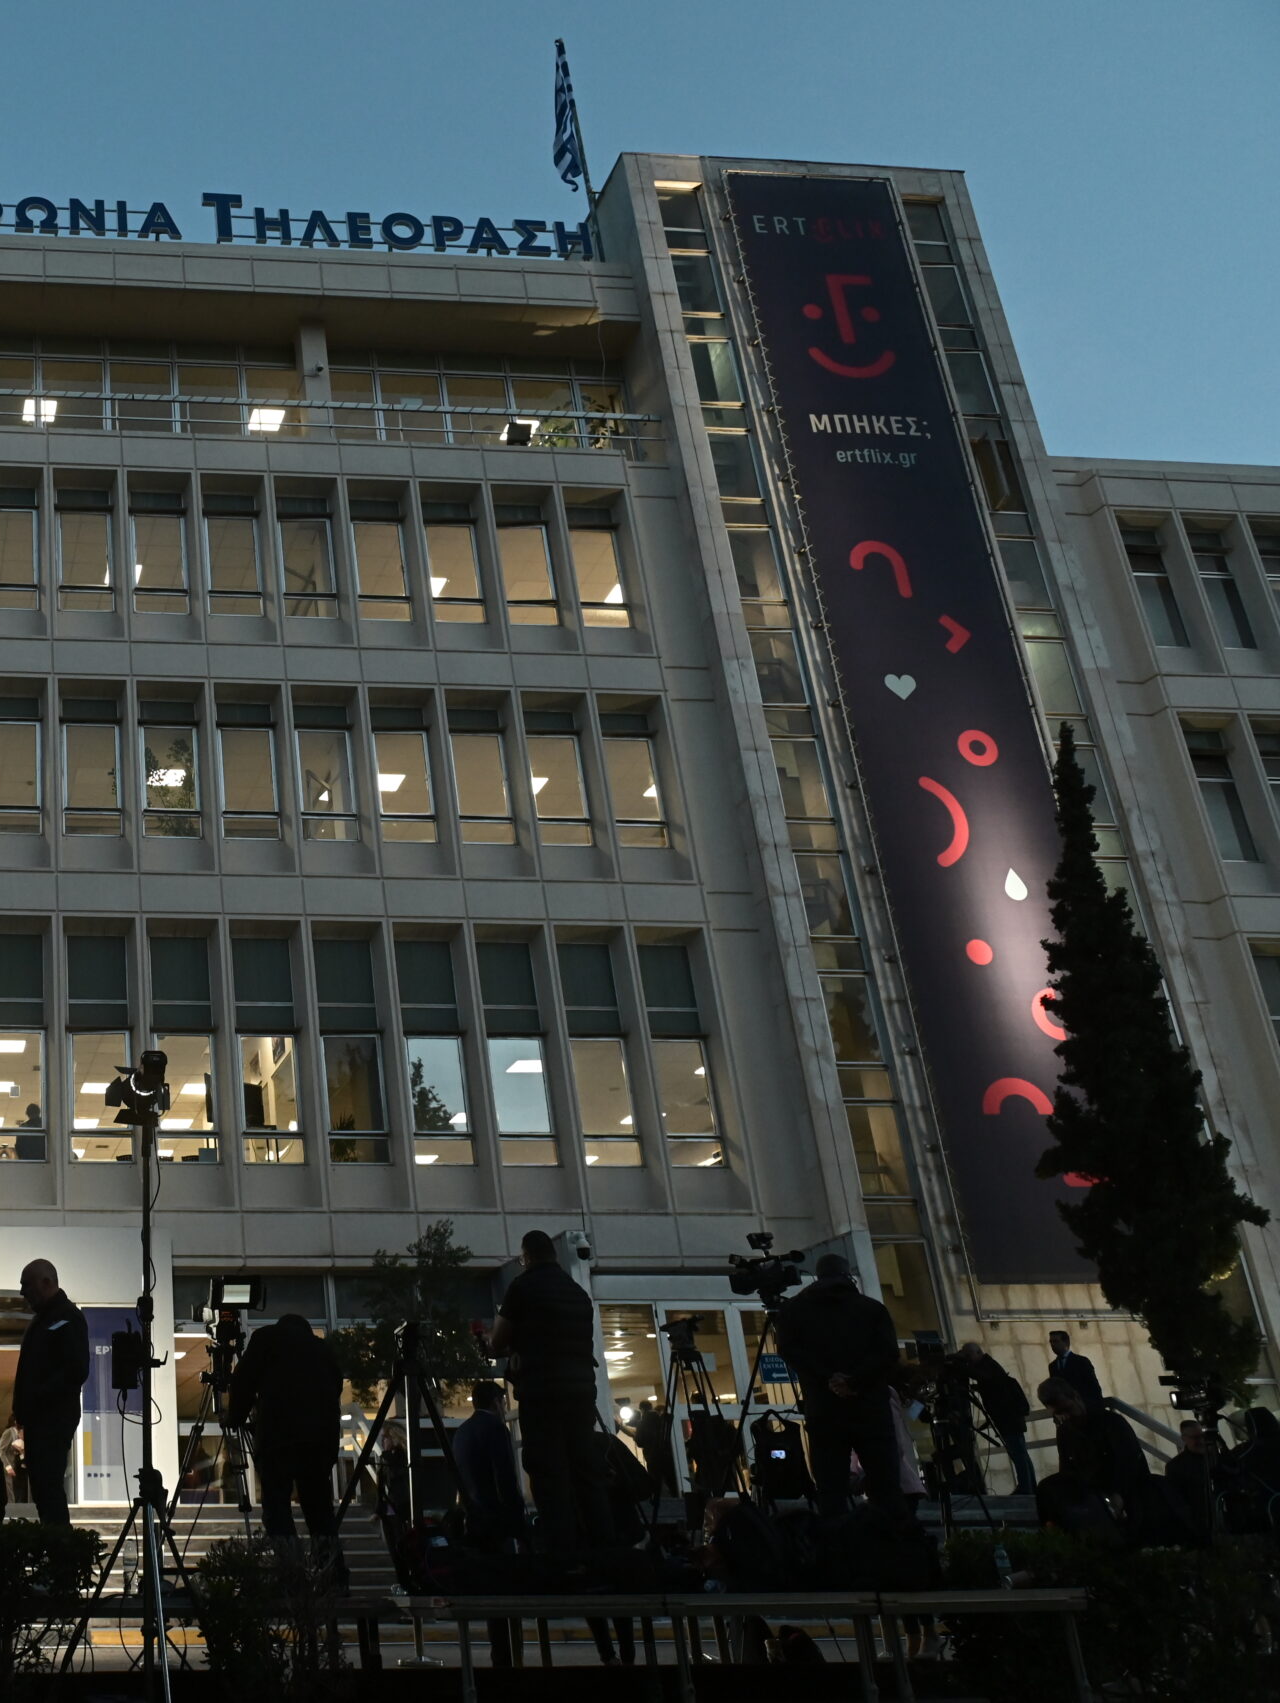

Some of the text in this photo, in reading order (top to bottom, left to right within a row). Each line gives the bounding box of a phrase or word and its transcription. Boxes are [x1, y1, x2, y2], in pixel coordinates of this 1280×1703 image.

[202, 192, 594, 261] ΤΗΛΕΟΡΑΣΗ
[809, 413, 932, 440] ΜΠΗΚΕΣ;
[836, 448, 918, 468] ertflix.gr
